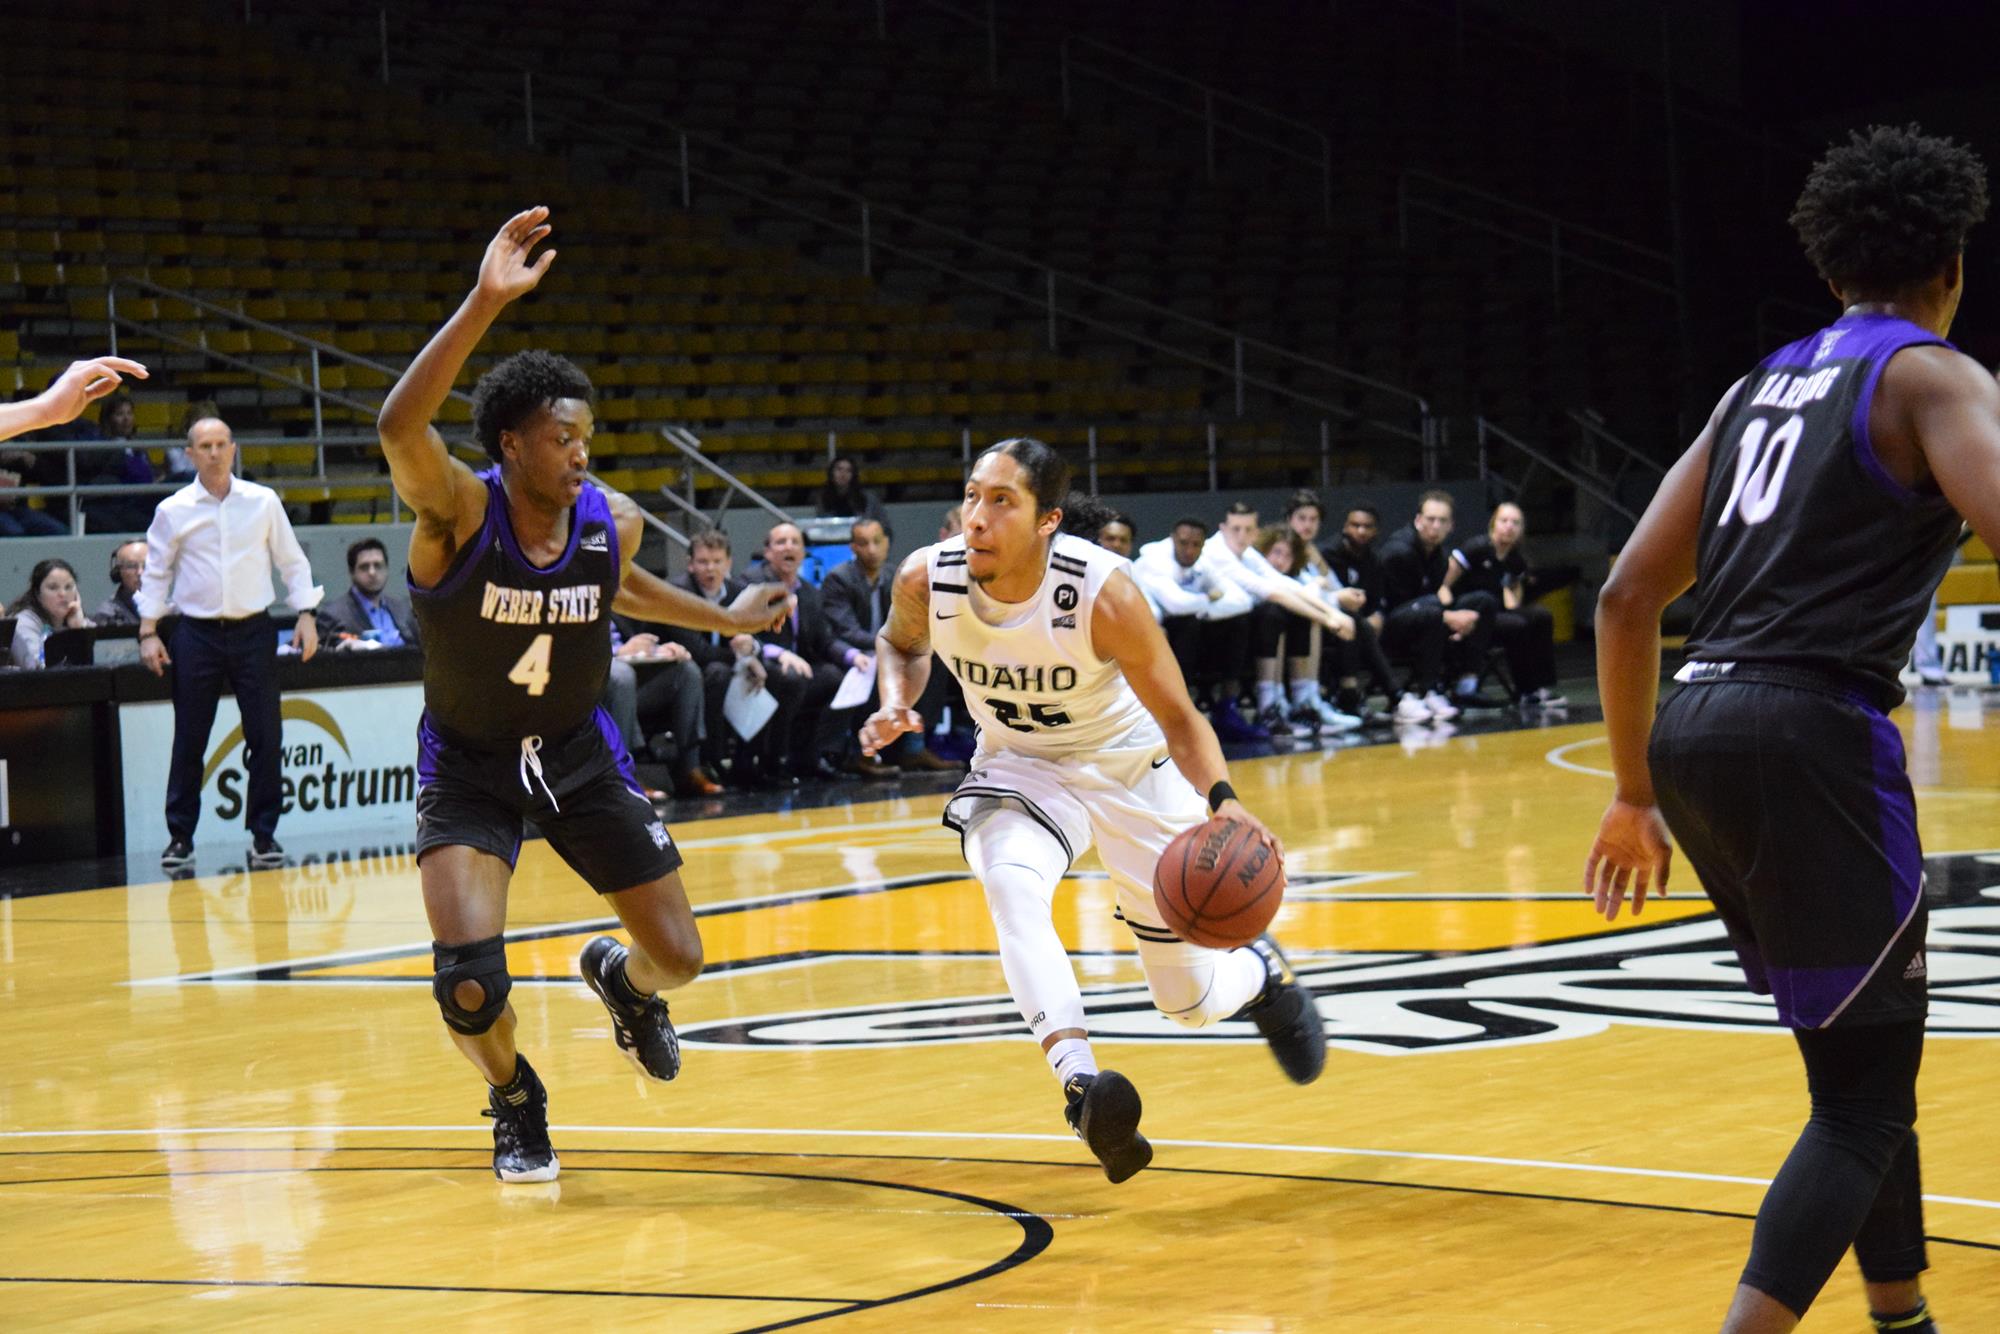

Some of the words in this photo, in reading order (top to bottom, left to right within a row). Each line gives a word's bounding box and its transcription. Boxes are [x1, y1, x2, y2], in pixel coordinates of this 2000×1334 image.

[1717, 414, 1804, 526] 10
[480, 580, 544, 625] WEBER
[547, 584, 602, 625] STATE
[507, 633, 553, 696] 4
[950, 654, 1077, 692] IDAHO
[242, 742, 323, 773] Cwan
[215, 762, 416, 820] Sectrum
